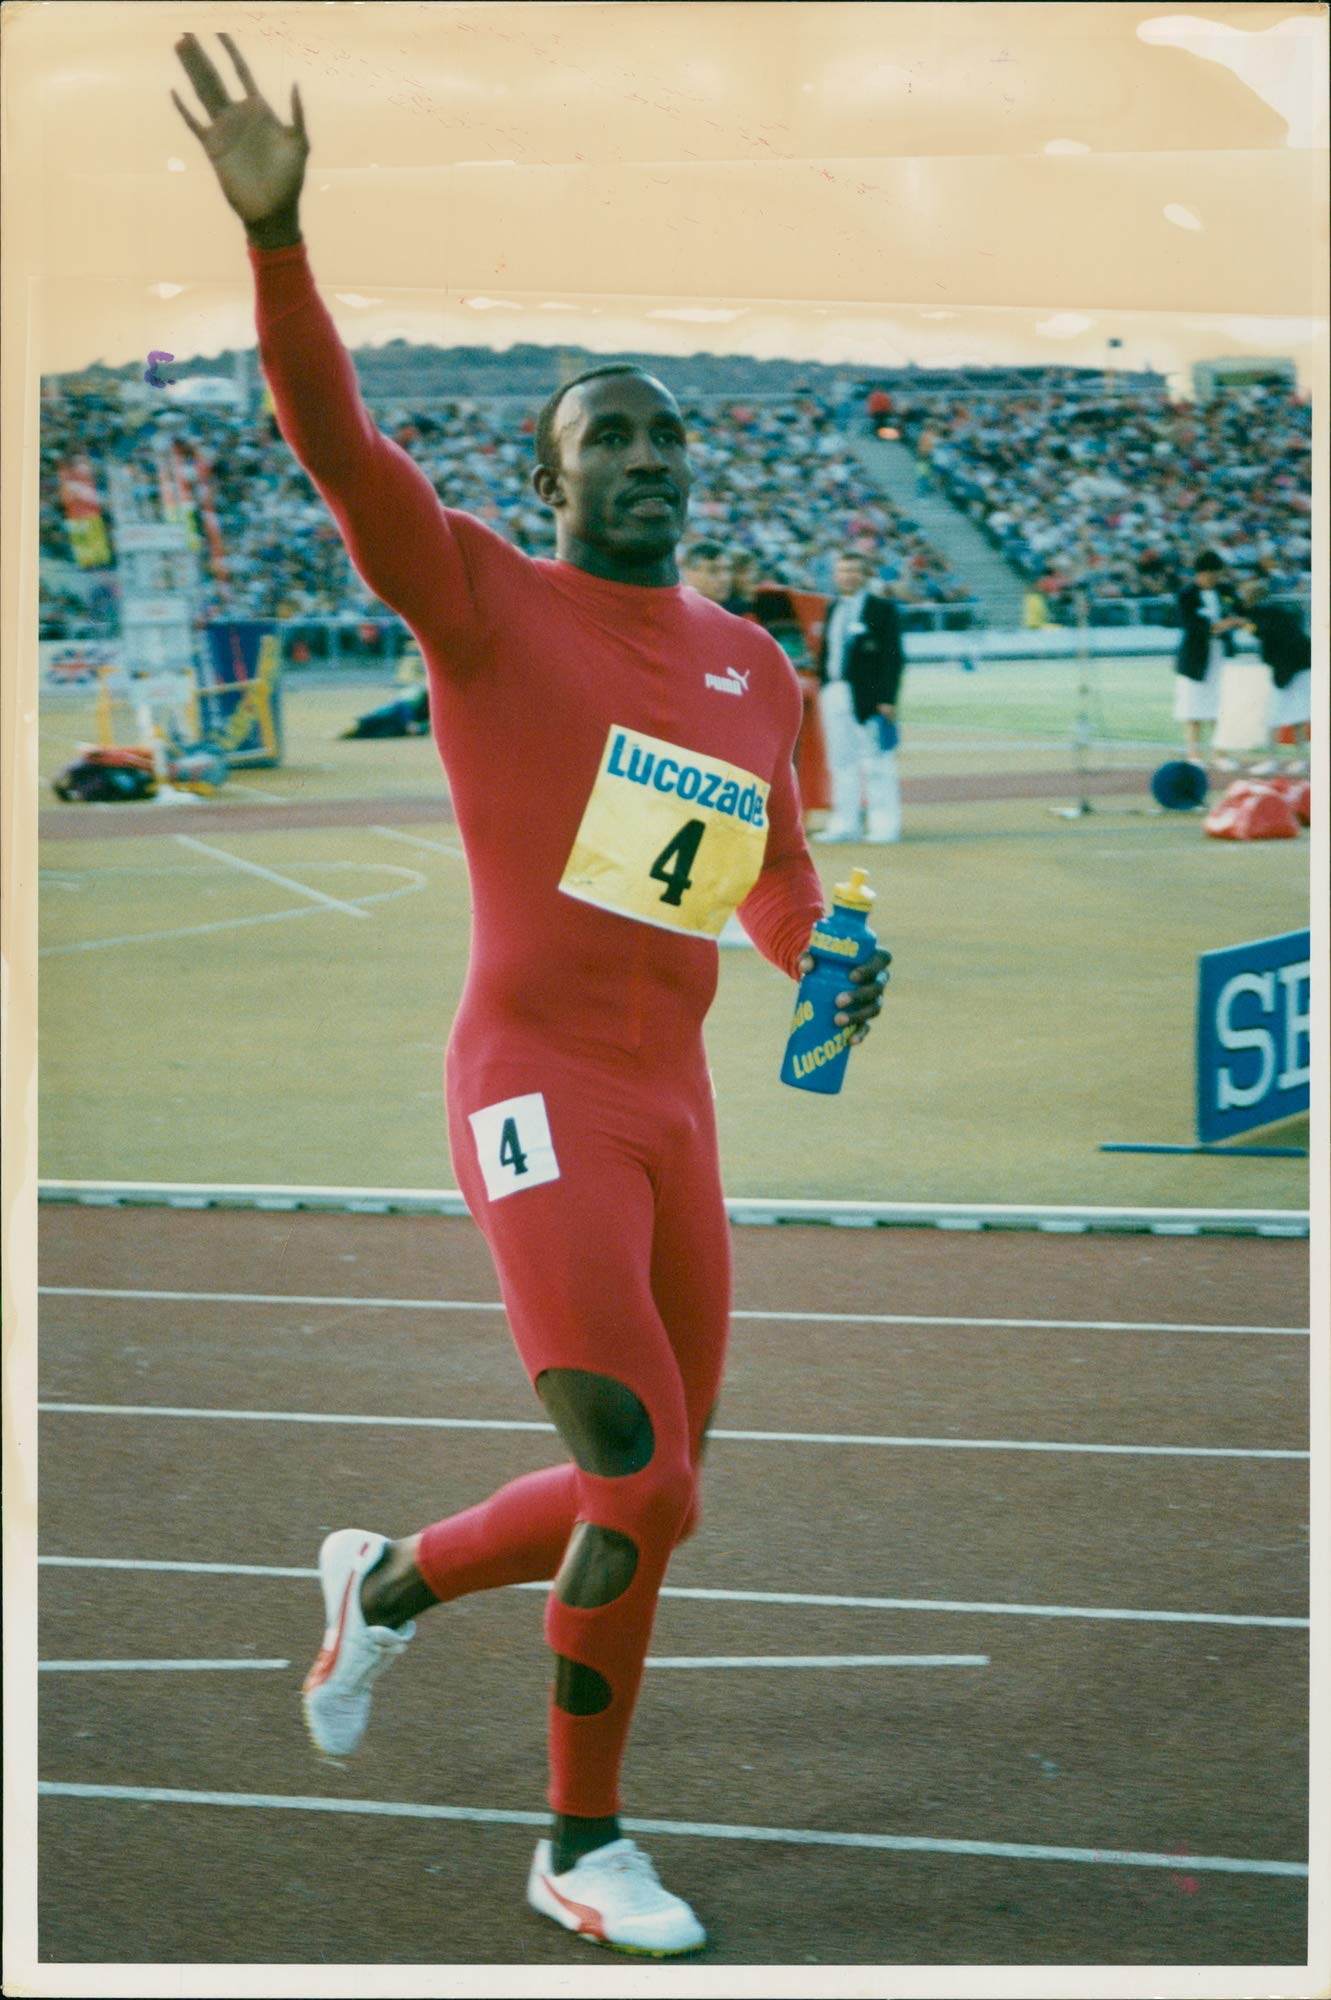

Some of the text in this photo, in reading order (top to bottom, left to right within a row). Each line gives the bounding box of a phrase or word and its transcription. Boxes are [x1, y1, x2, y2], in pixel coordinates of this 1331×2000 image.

[607, 734, 764, 828] Lucozade
[649, 818, 706, 907] 4
[500, 1117, 528, 1175] 4
